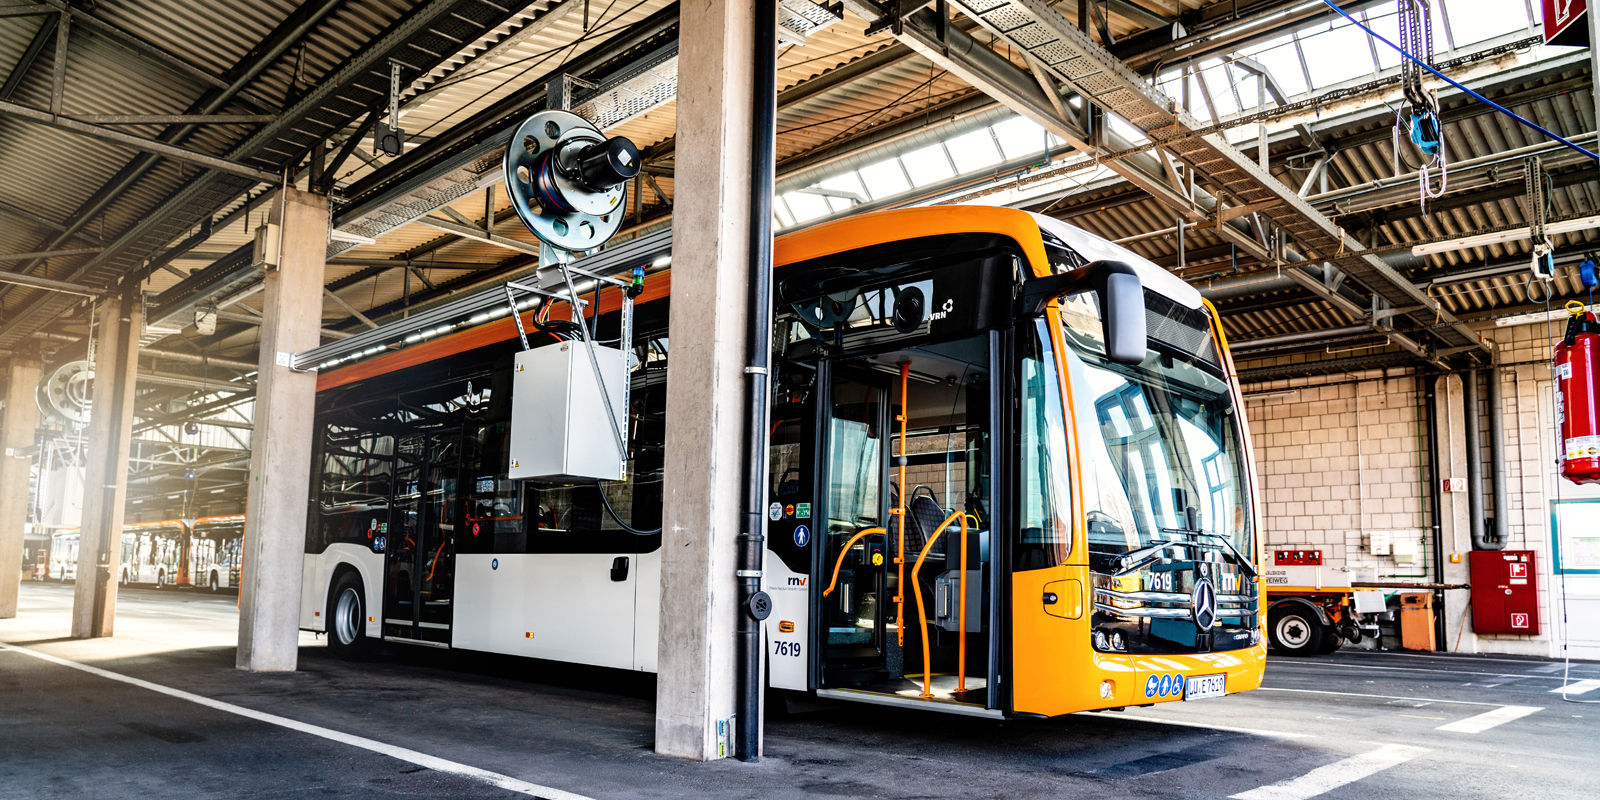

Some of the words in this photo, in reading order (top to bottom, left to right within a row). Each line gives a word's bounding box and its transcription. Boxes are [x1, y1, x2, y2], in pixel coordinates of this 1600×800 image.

[930, 310, 946, 321] VRN
[788, 577, 807, 586] rnv
[1148, 572, 1172, 590] 7619
[774, 640, 801, 657] 7619
